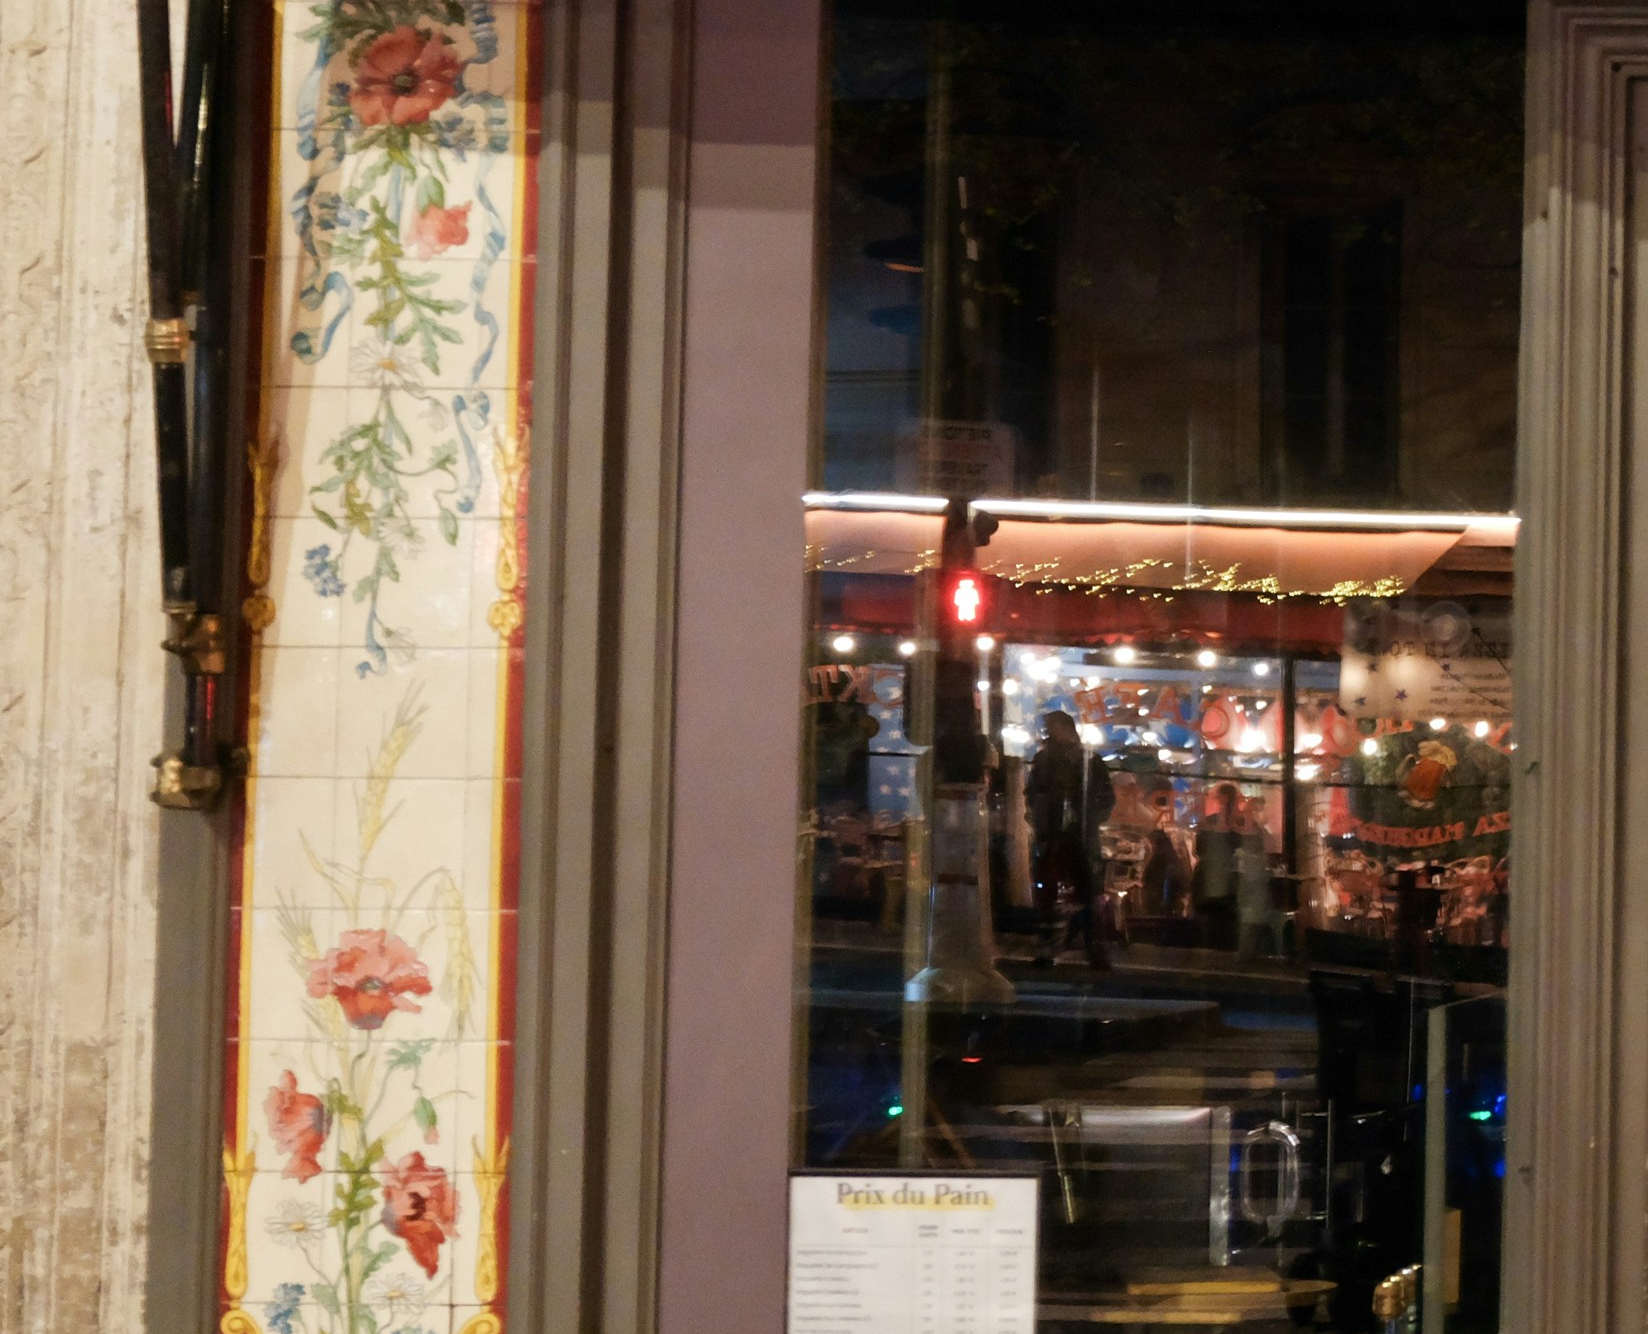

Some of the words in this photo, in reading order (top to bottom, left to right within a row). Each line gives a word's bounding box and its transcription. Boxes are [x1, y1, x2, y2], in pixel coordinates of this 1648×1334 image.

[836, 1182, 885, 1205] Prix
[892, 1182, 926, 1206] du
[934, 1183, 989, 1206] Pain
